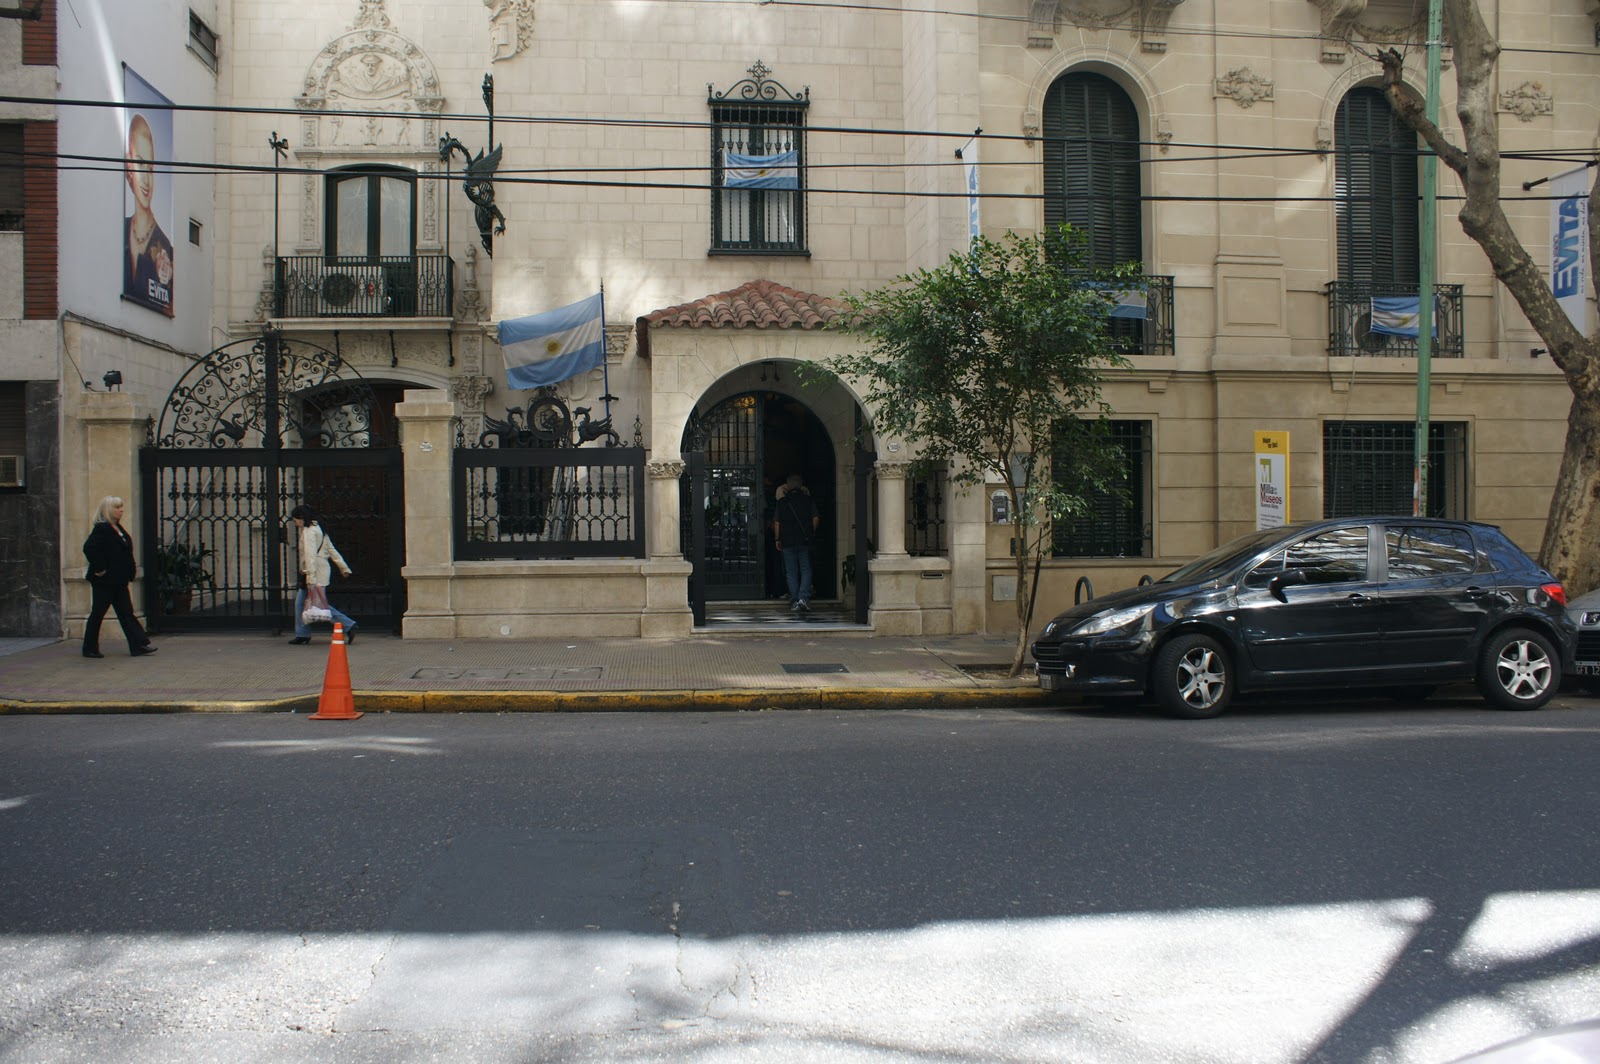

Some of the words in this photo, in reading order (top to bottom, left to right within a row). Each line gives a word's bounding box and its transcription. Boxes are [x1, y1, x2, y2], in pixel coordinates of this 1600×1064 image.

[1553, 191, 1579, 299] EVITA
[148, 278, 170, 303] EVITA
[1260, 491, 1283, 505] Museos
